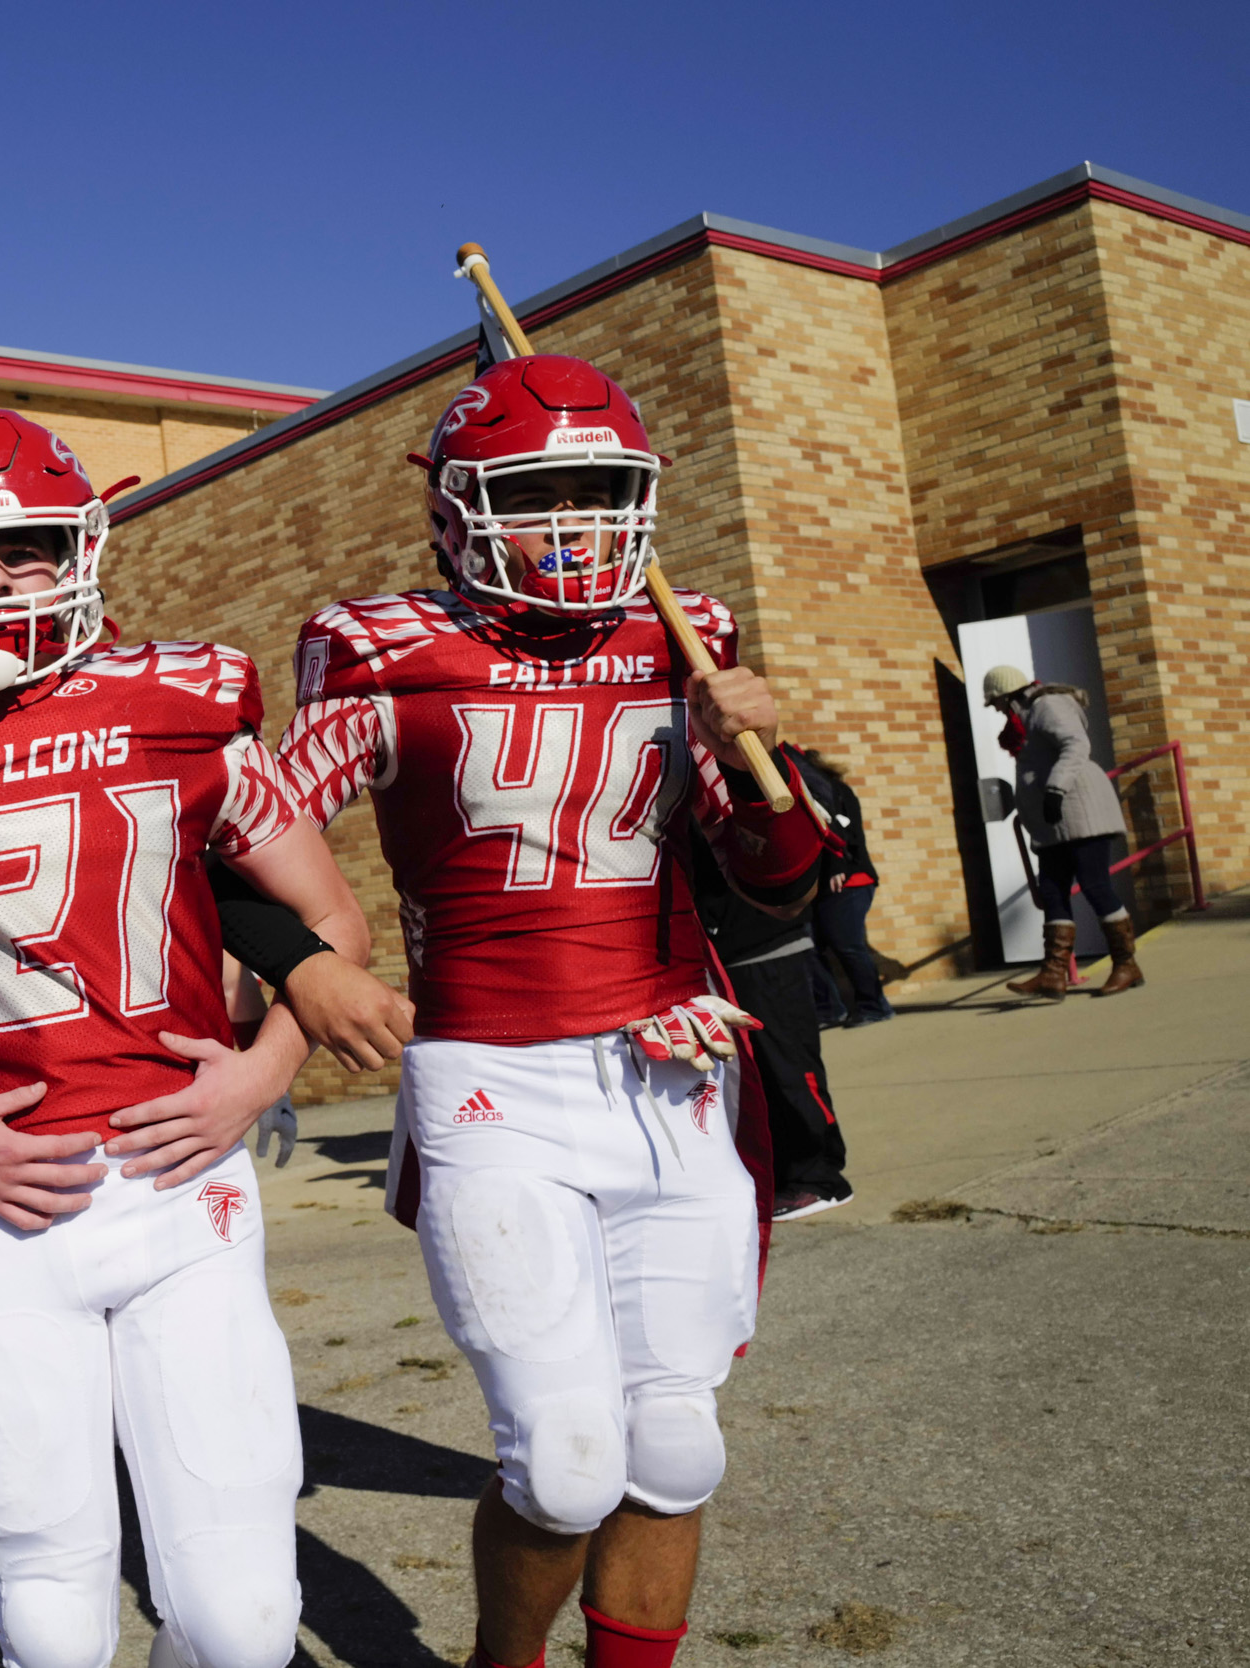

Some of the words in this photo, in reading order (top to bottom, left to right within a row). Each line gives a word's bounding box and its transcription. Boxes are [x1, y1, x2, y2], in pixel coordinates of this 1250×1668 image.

[556, 430, 613, 444] Riddell
[488, 655, 655, 691] FALCONS
[451, 698, 692, 891] 40
[453, 1109, 504, 1124] adidas
